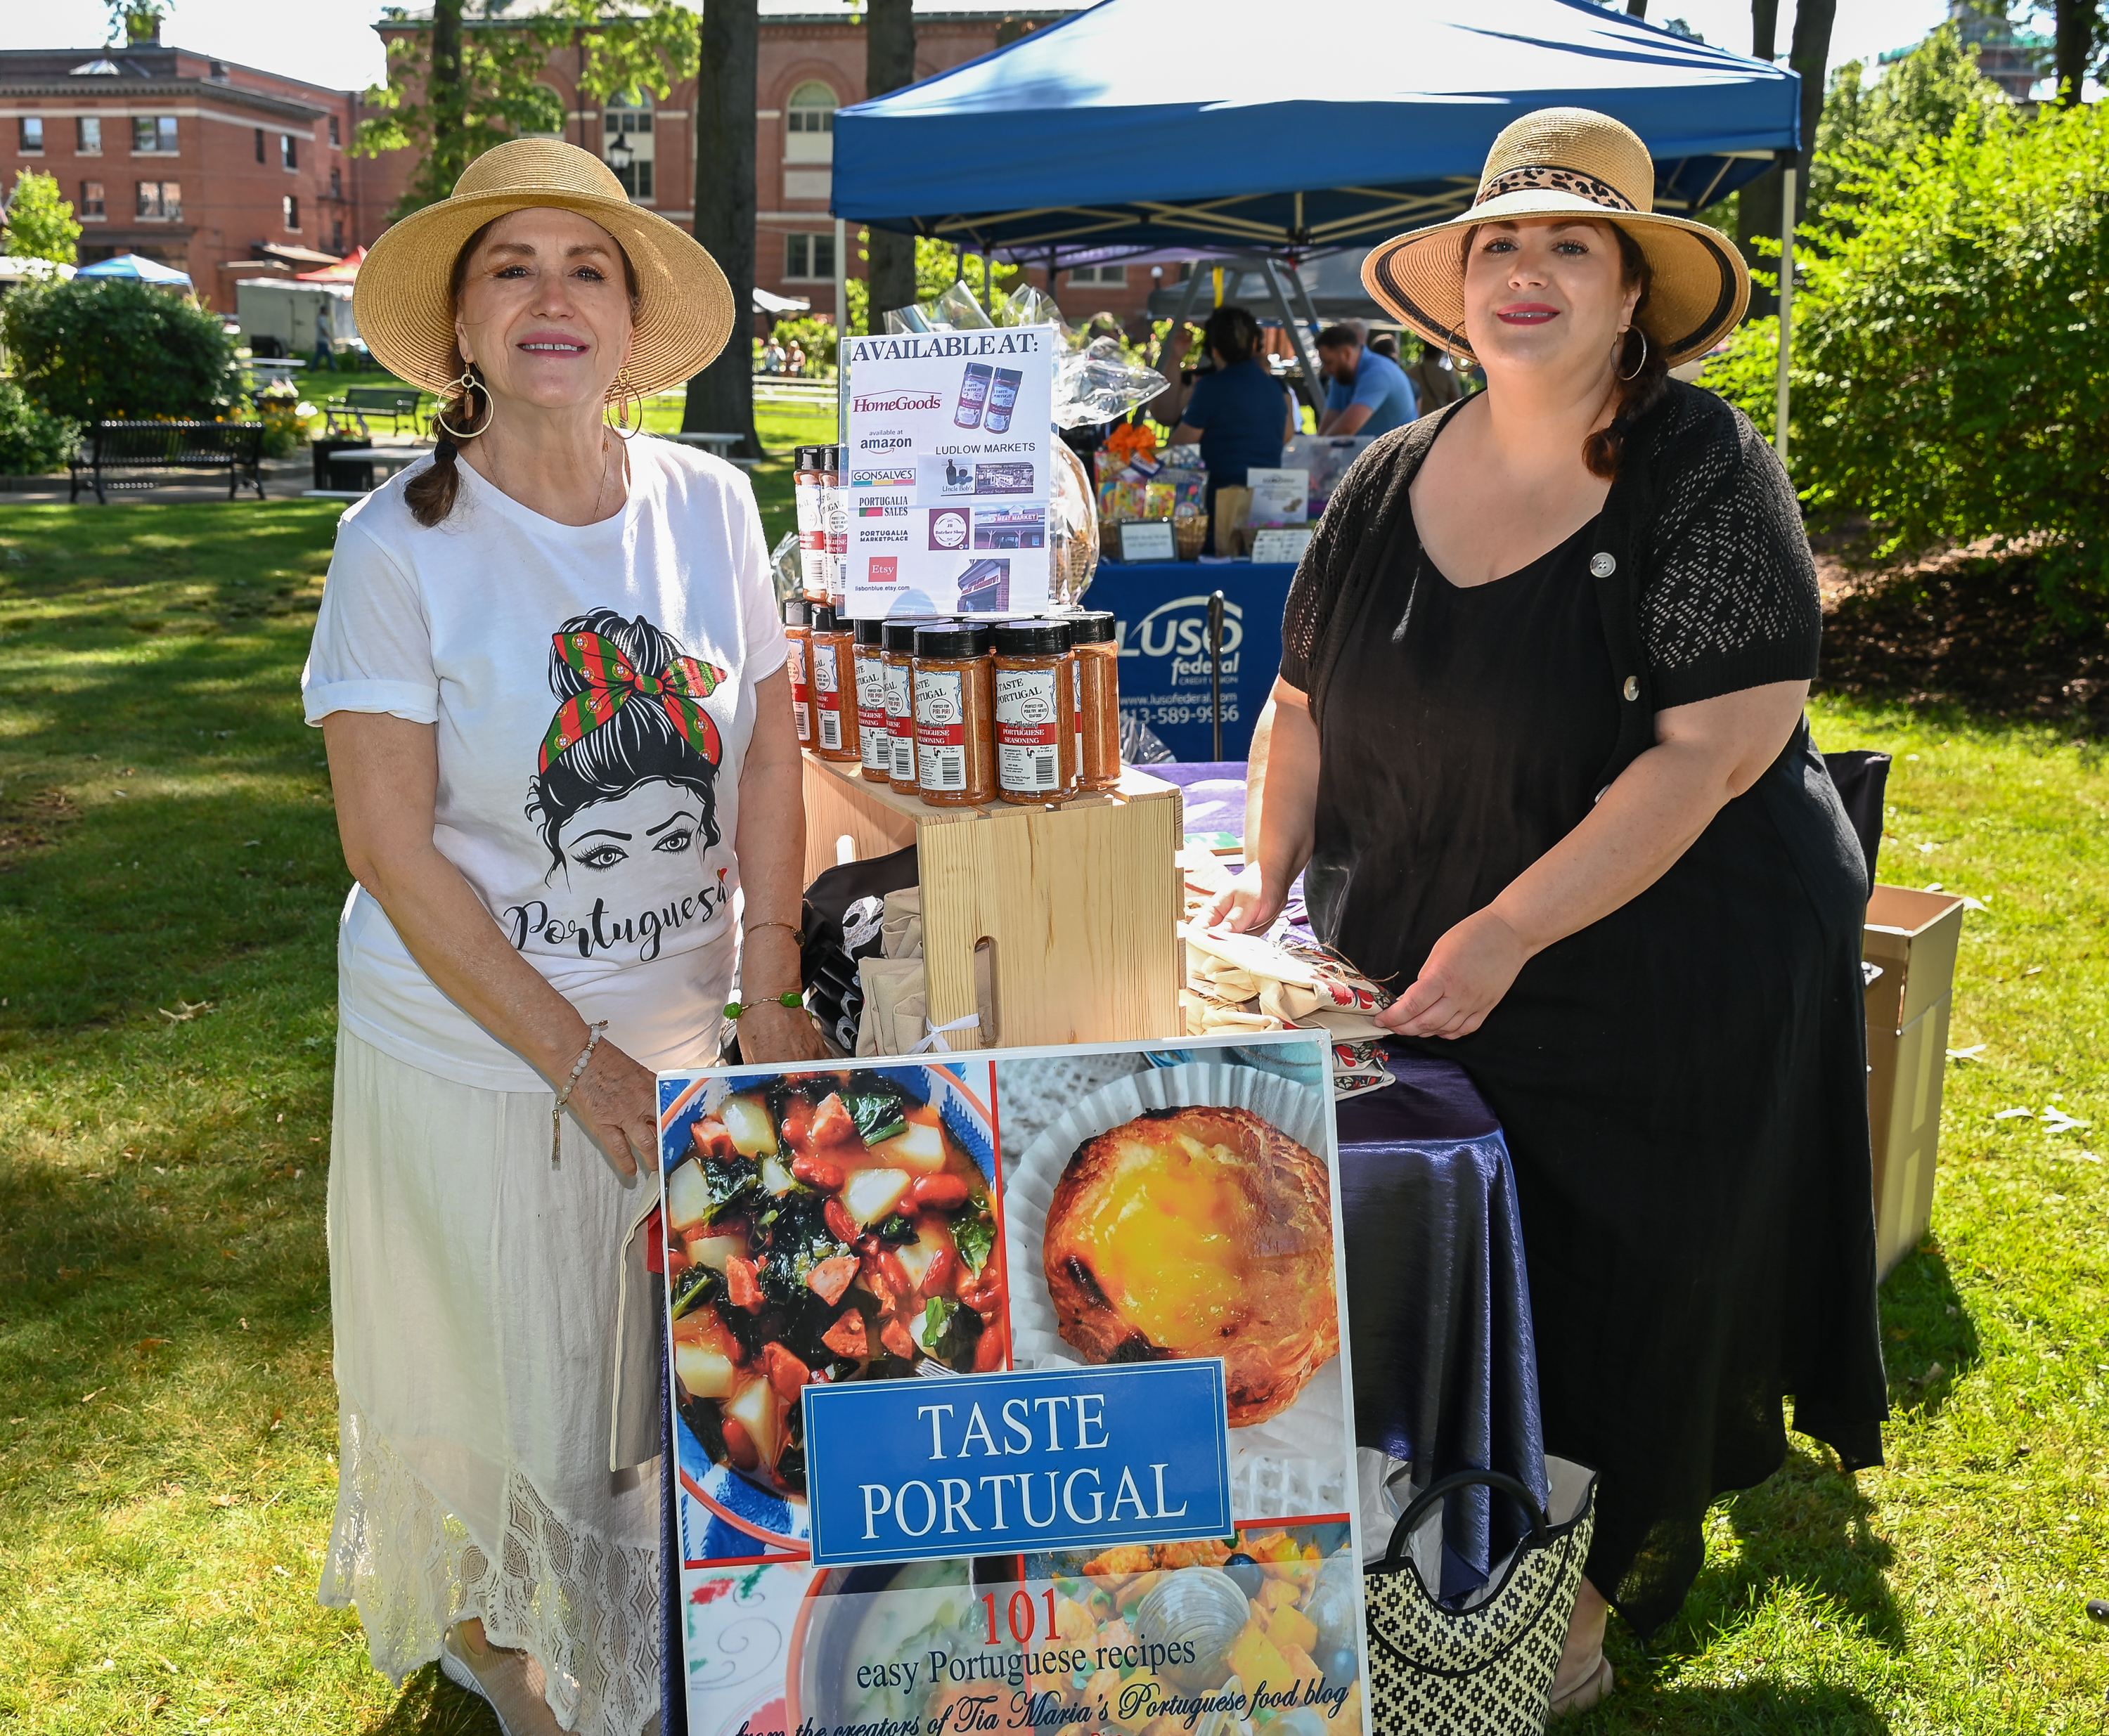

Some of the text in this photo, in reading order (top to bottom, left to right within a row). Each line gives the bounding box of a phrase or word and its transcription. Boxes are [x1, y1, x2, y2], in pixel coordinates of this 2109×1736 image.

[852, 333, 1038, 361] AVAILABLE AT:
[853, 395, 941, 413] HomeGoods
[860, 437, 912, 450] amazon
[936, 443, 1036, 455] LUDLOW MARKETS
[853, 470, 912, 481] GONSALVES
[859, 496, 908, 506] PORTUGALIA
[884, 507, 908, 517] SALES
[872, 564, 894, 575] Etsy
[1170, 652, 1240, 686] fedeal
[915, 679, 930, 689] ASTE
[998, 678, 1024, 692] TASTE
[1208, 675, 1239, 685] ION
[916, 688, 946, 702] RTUGAL
[998, 687, 1042, 705] PORTUGAL
[1120, 692, 1238, 706] www.lusofederal.om
[917, 1394, 1110, 1460] TASTE
[858, 1463, 1188, 1540] PORTUGAL
[981, 1588, 1062, 1645] 101
[856, 1633, 1196, 1695] easy Portuguese recipes
[796, 1716, 827, 1736] the
[833, 1715, 920, 1736] creators
[927, 1705, 955, 1735] of
[955, 1695, 1001, 1733] Tia
[1007, 1690, 1109, 1729] Maria's
[1118, 1683, 1246, 1730] Portuguese
[1241, 1680, 1301, 1721] food
[1303, 1676, 1348, 1718] blog
